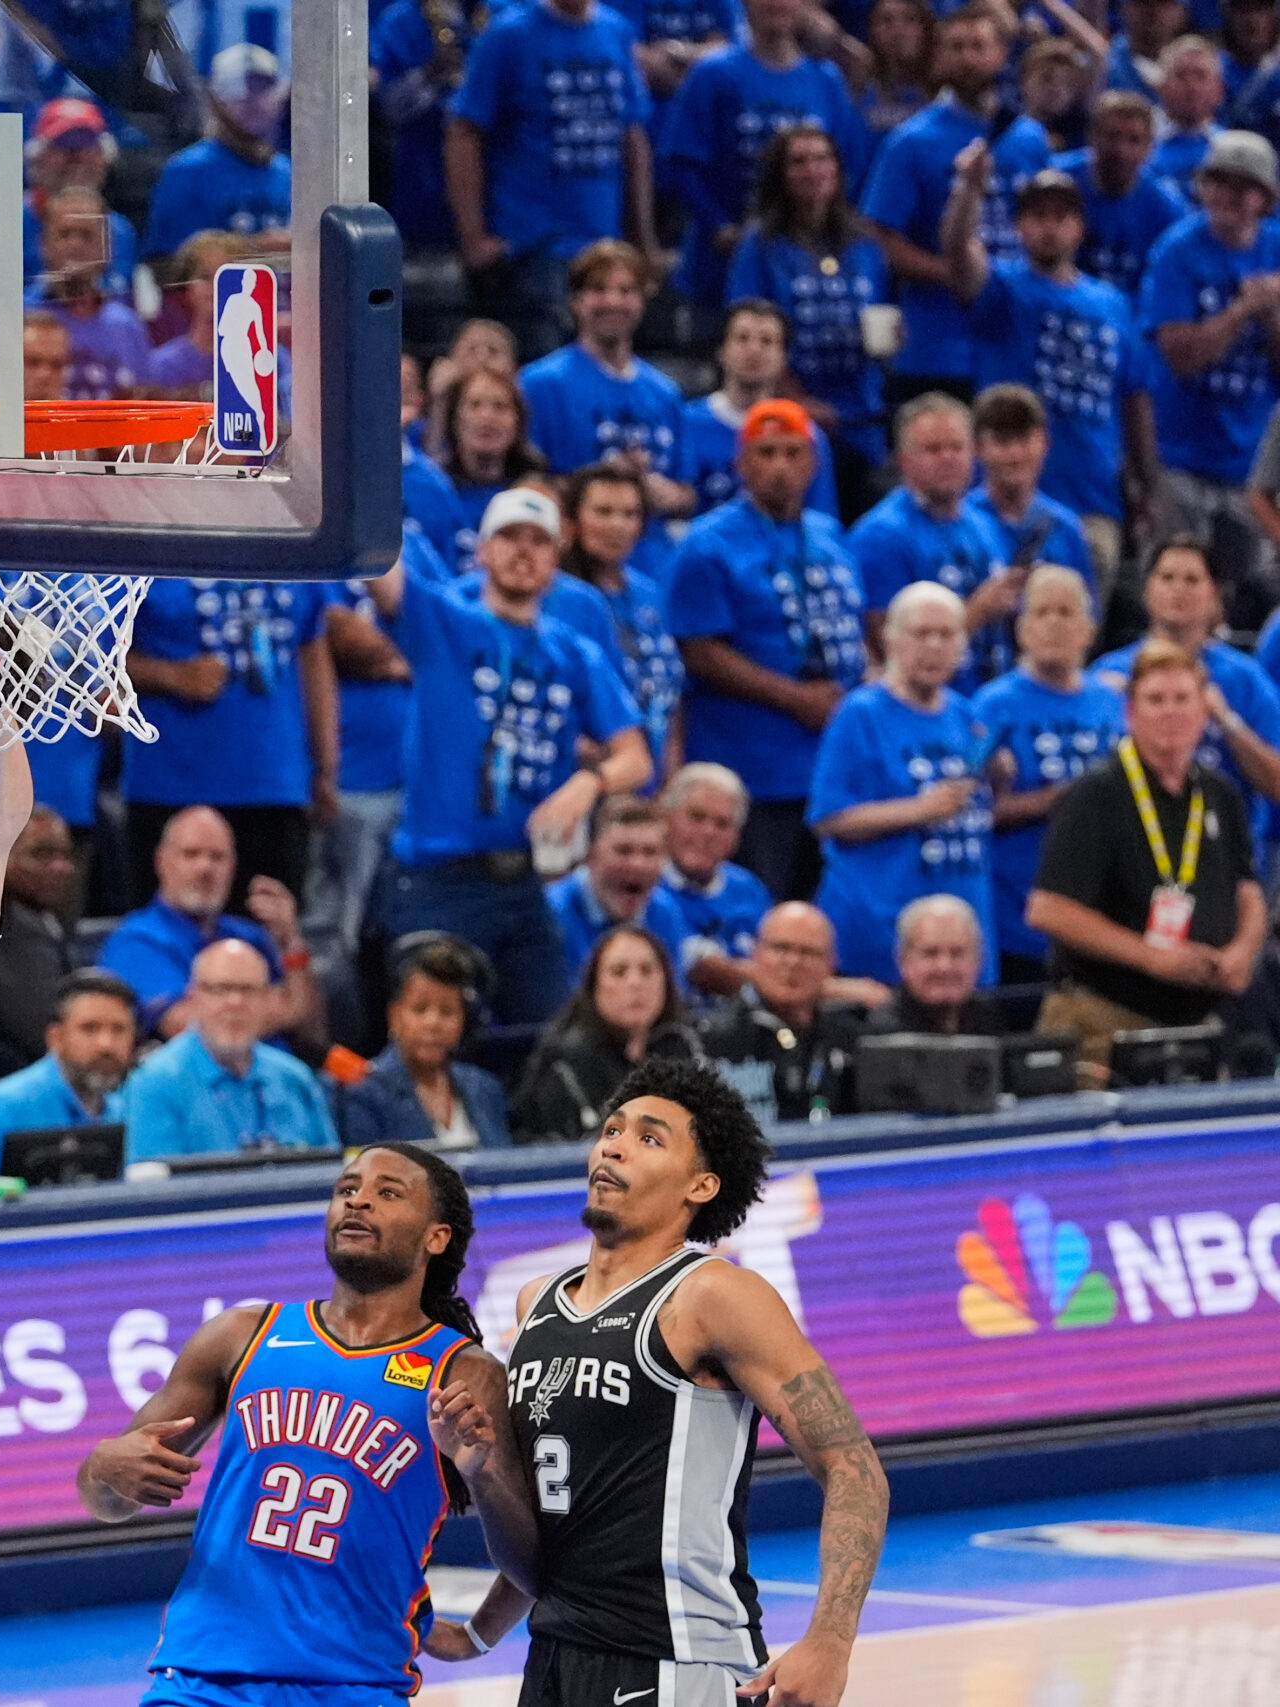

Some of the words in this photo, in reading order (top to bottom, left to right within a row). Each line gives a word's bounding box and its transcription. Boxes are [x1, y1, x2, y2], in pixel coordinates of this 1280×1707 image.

[597, 1316, 629, 1328] LEDGER
[234, 1387, 422, 1492] THUNDER
[533, 1434, 572, 1515] 2
[246, 1462, 352, 1564] 22
